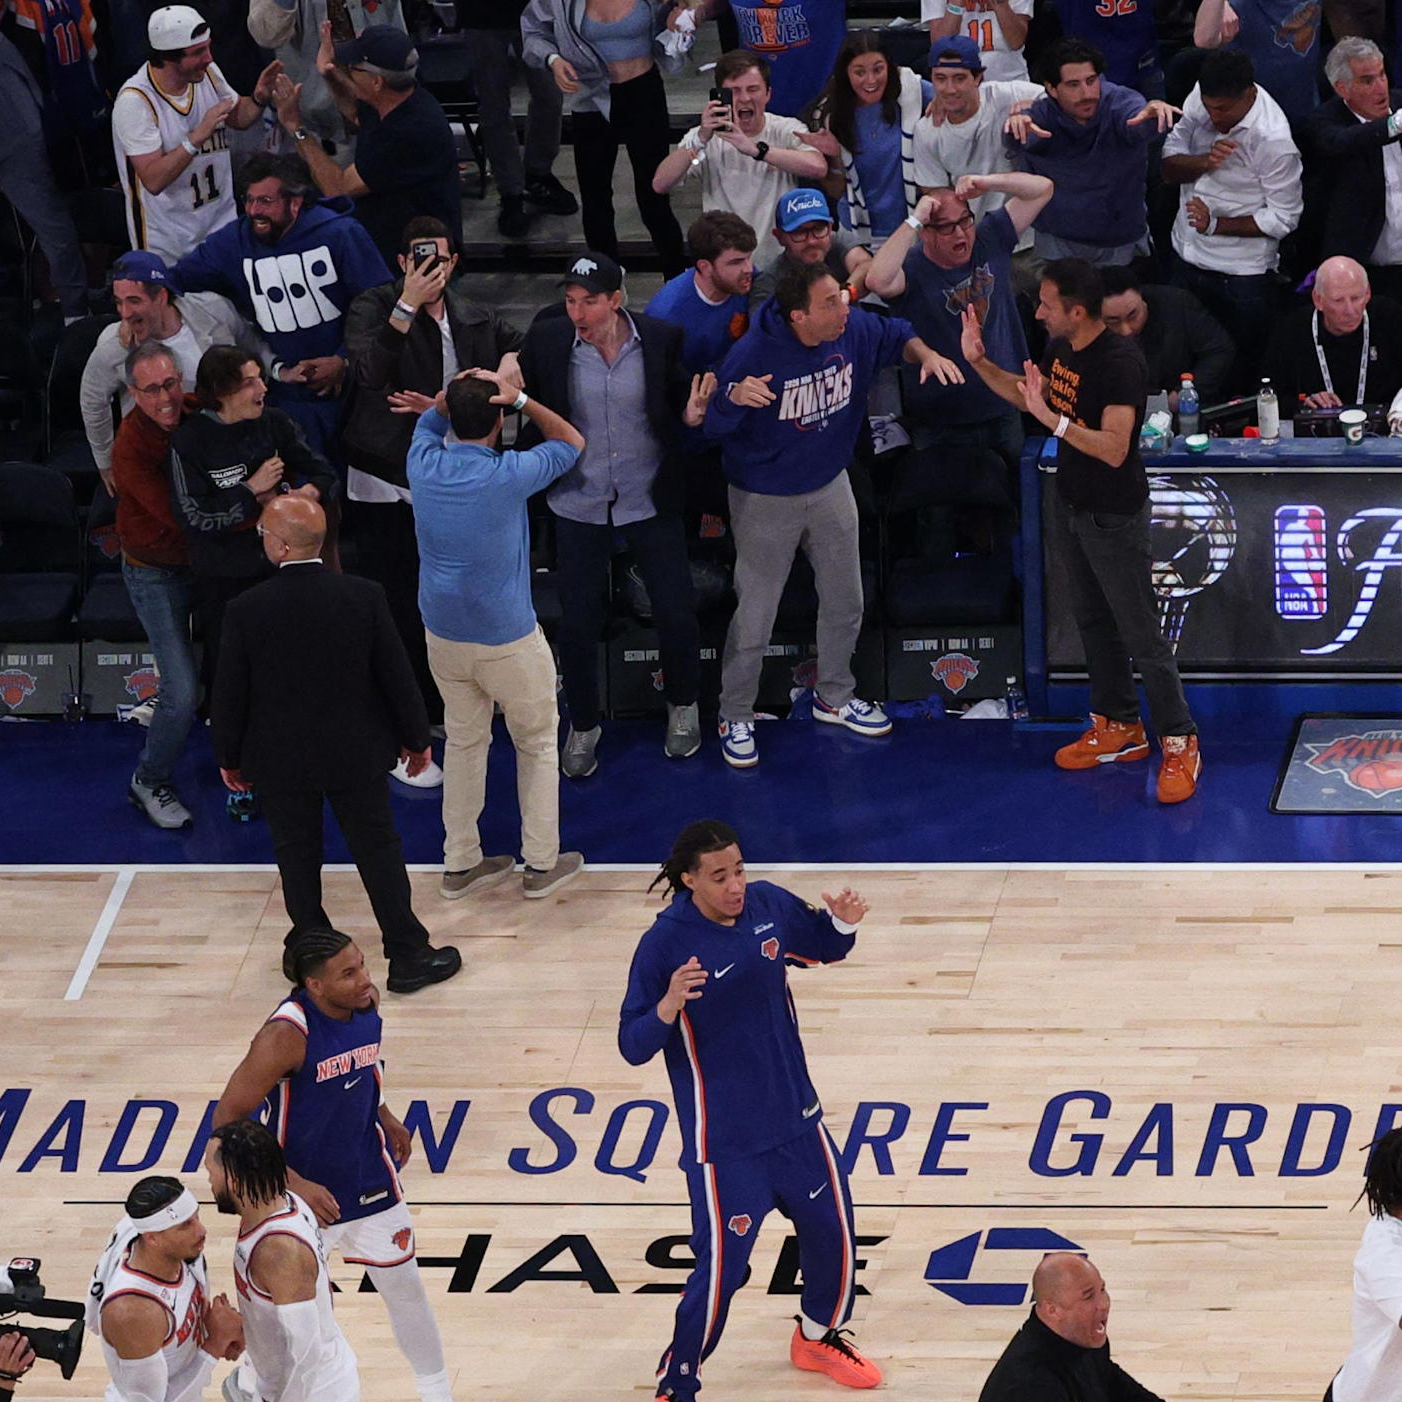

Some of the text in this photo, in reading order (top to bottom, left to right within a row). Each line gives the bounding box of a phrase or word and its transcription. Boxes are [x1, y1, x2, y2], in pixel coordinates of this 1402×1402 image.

[53, 20, 81, 66] 11
[190, 163, 220, 210] 11
[243, 245, 342, 333] LOOP
[778, 362, 853, 421] KNICKS
[1283, 592, 1309, 612] NBA
[316, 1050, 353, 1084] NEW
[508, 1086, 990, 1184] SQRE
[331, 1233, 891, 1295] HASE
